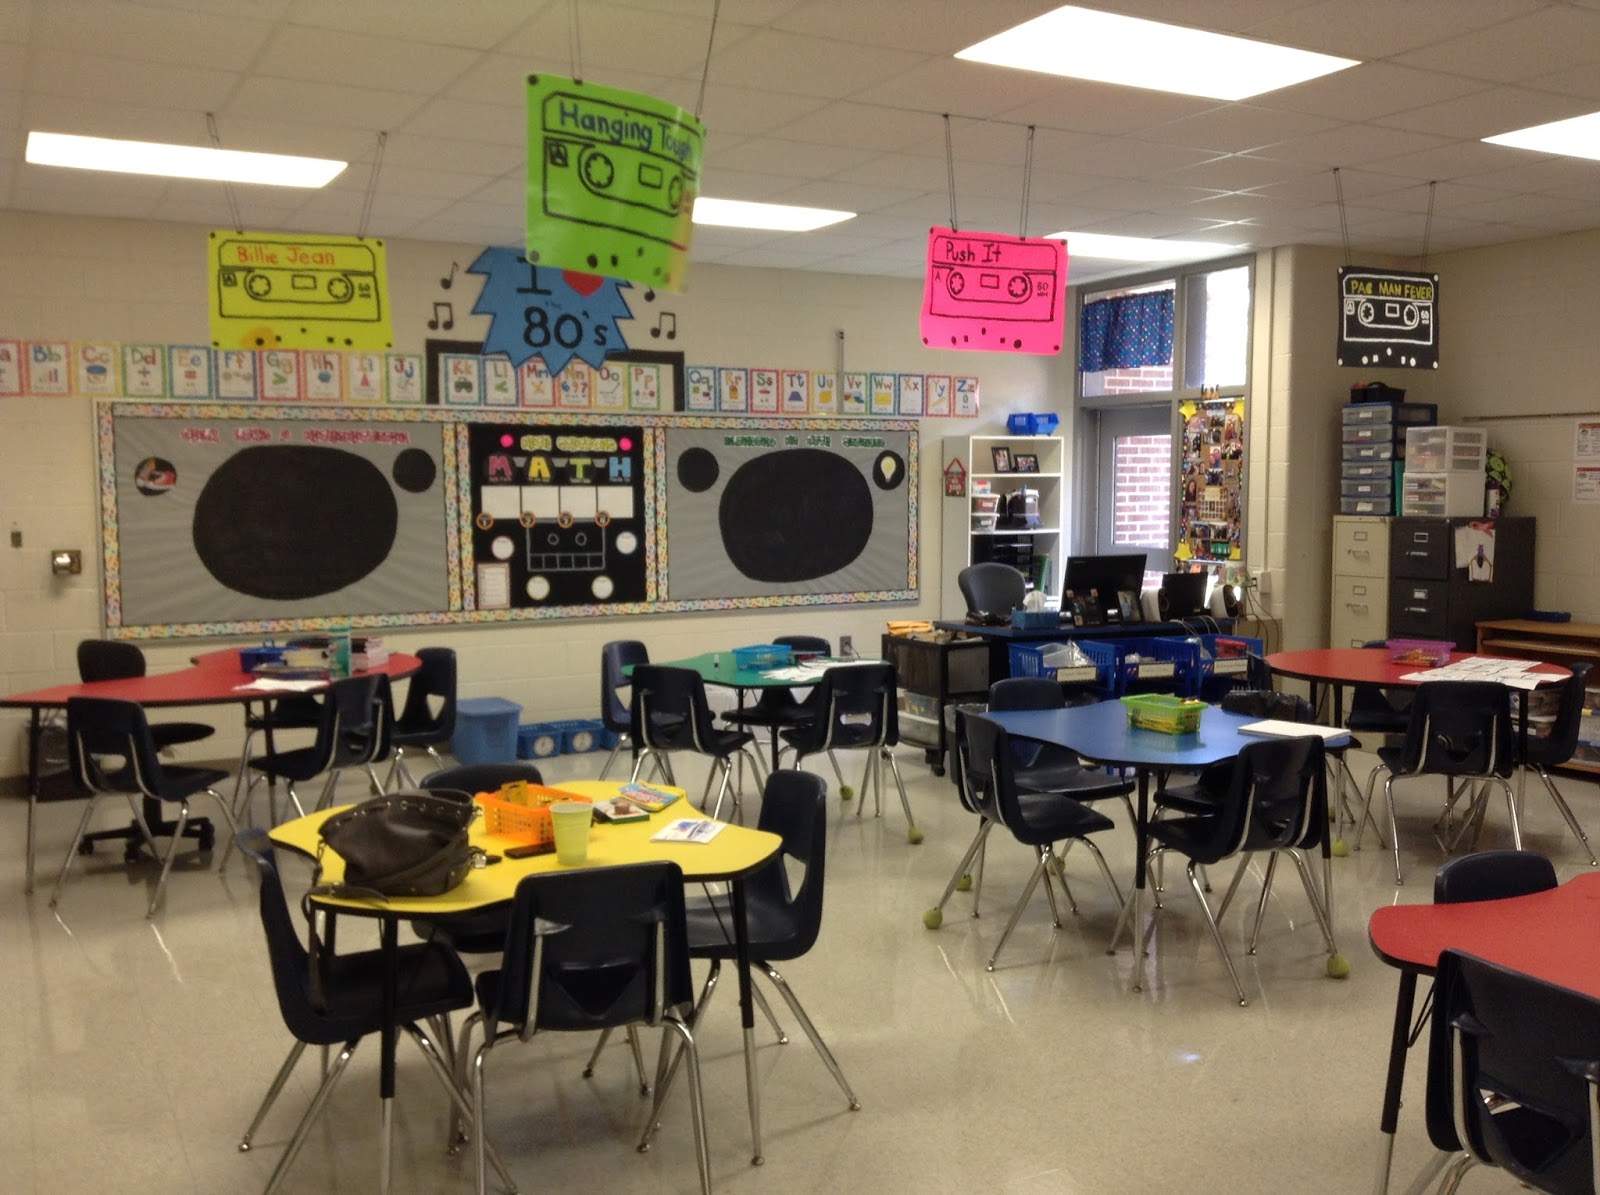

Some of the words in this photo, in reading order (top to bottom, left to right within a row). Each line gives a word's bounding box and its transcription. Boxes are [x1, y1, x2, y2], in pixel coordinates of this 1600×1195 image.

[558, 100, 652, 150] Hanging
[236, 245, 279, 264] Billie
[287, 246, 336, 265] Jean
[946, 241, 976, 262] Push
[981, 242, 1002, 263] It
[1379, 281, 1402, 296] MAN
[1404, 284, 1433, 300] FEVER
[523, 306, 609, 349] 80's
[33, 345, 62, 363] Bb
[81, 346, 110, 363] Cc
[130, 349, 157, 366] Dd
[177, 350, 201, 367] Ee
[223, 350, 246, 369] Ff
[311, 354, 335, 371] Hh
[266, 353, 293, 374] Gg
[394, 358, 414, 379] Jj
[452, 360, 473, 375] Kk
[493, 361, 509, 378] Ll
[600, 367, 620, 382] Oo
[634, 368, 654, 390] Pp
[690, 370, 712, 391] Qq
[757, 373, 773, 387] Ss
[786, 374, 804, 388] Tt
[817, 375, 833, 388] Uu
[847, 375, 861, 389] Vv
[874, 376, 892, 390] Ww
[903, 377, 919, 391] Xx
[932, 379, 945, 397] Yy
[957, 379, 975, 393] Zz
[488, 455, 632, 479] MATH
